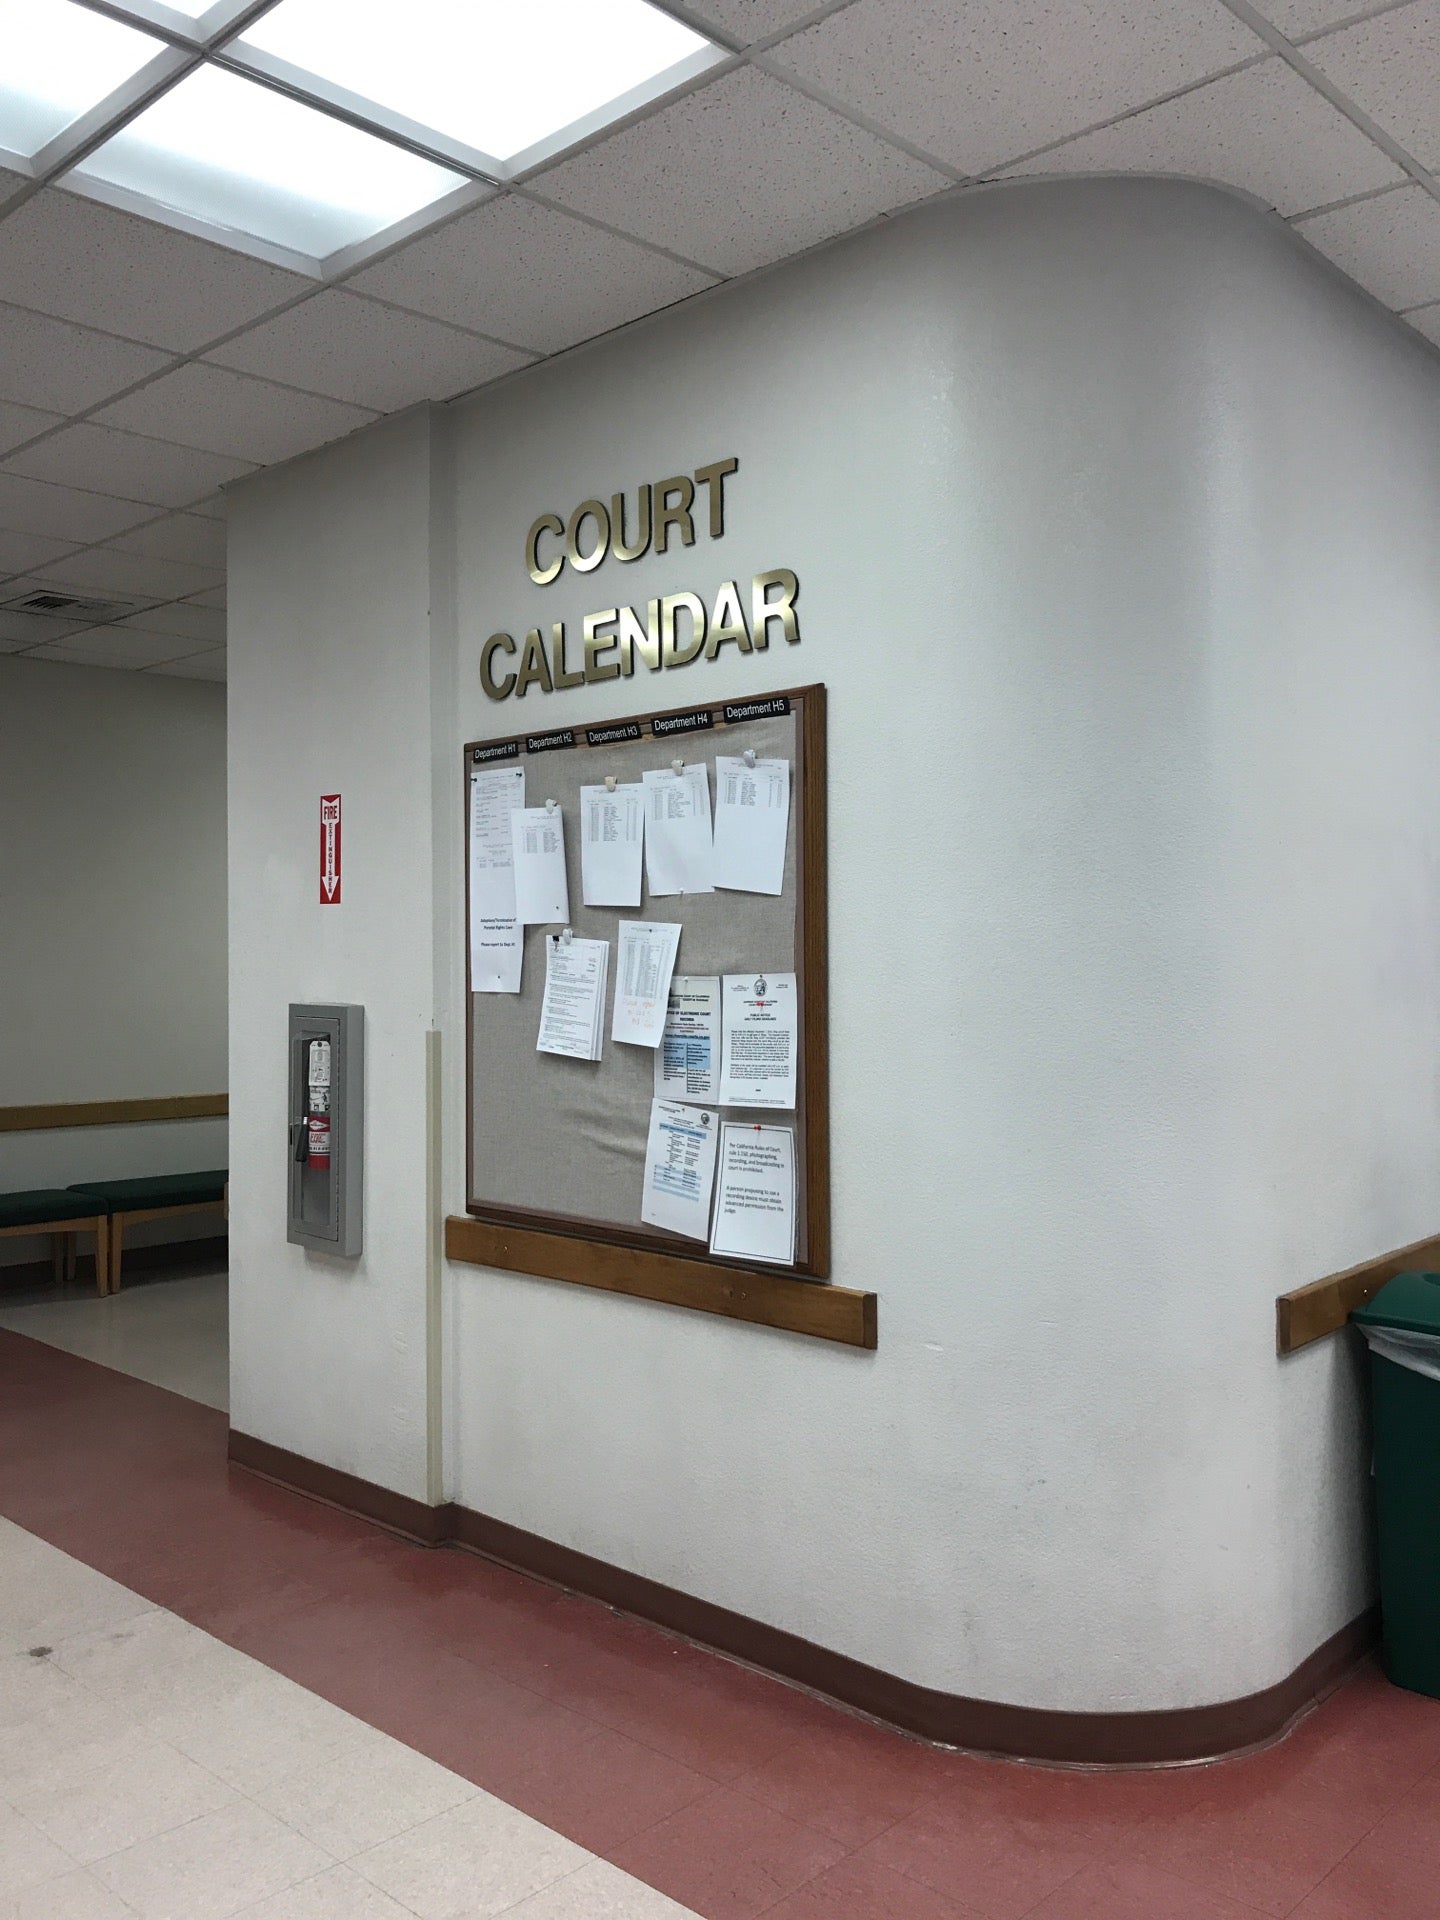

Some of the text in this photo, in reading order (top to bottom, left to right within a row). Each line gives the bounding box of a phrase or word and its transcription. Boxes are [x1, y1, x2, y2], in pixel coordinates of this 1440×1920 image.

[526, 457, 738, 586] COURT
[480, 568, 800, 700] CALENDAR
[727, 701, 784, 720] Department H5
[654, 714, 708, 732] Department H4
[528, 733, 572, 750] Department H2
[589, 725, 637, 744] Department H3
[475, 744, 516, 760] Department H1
[324, 806, 338, 820] FIRE
